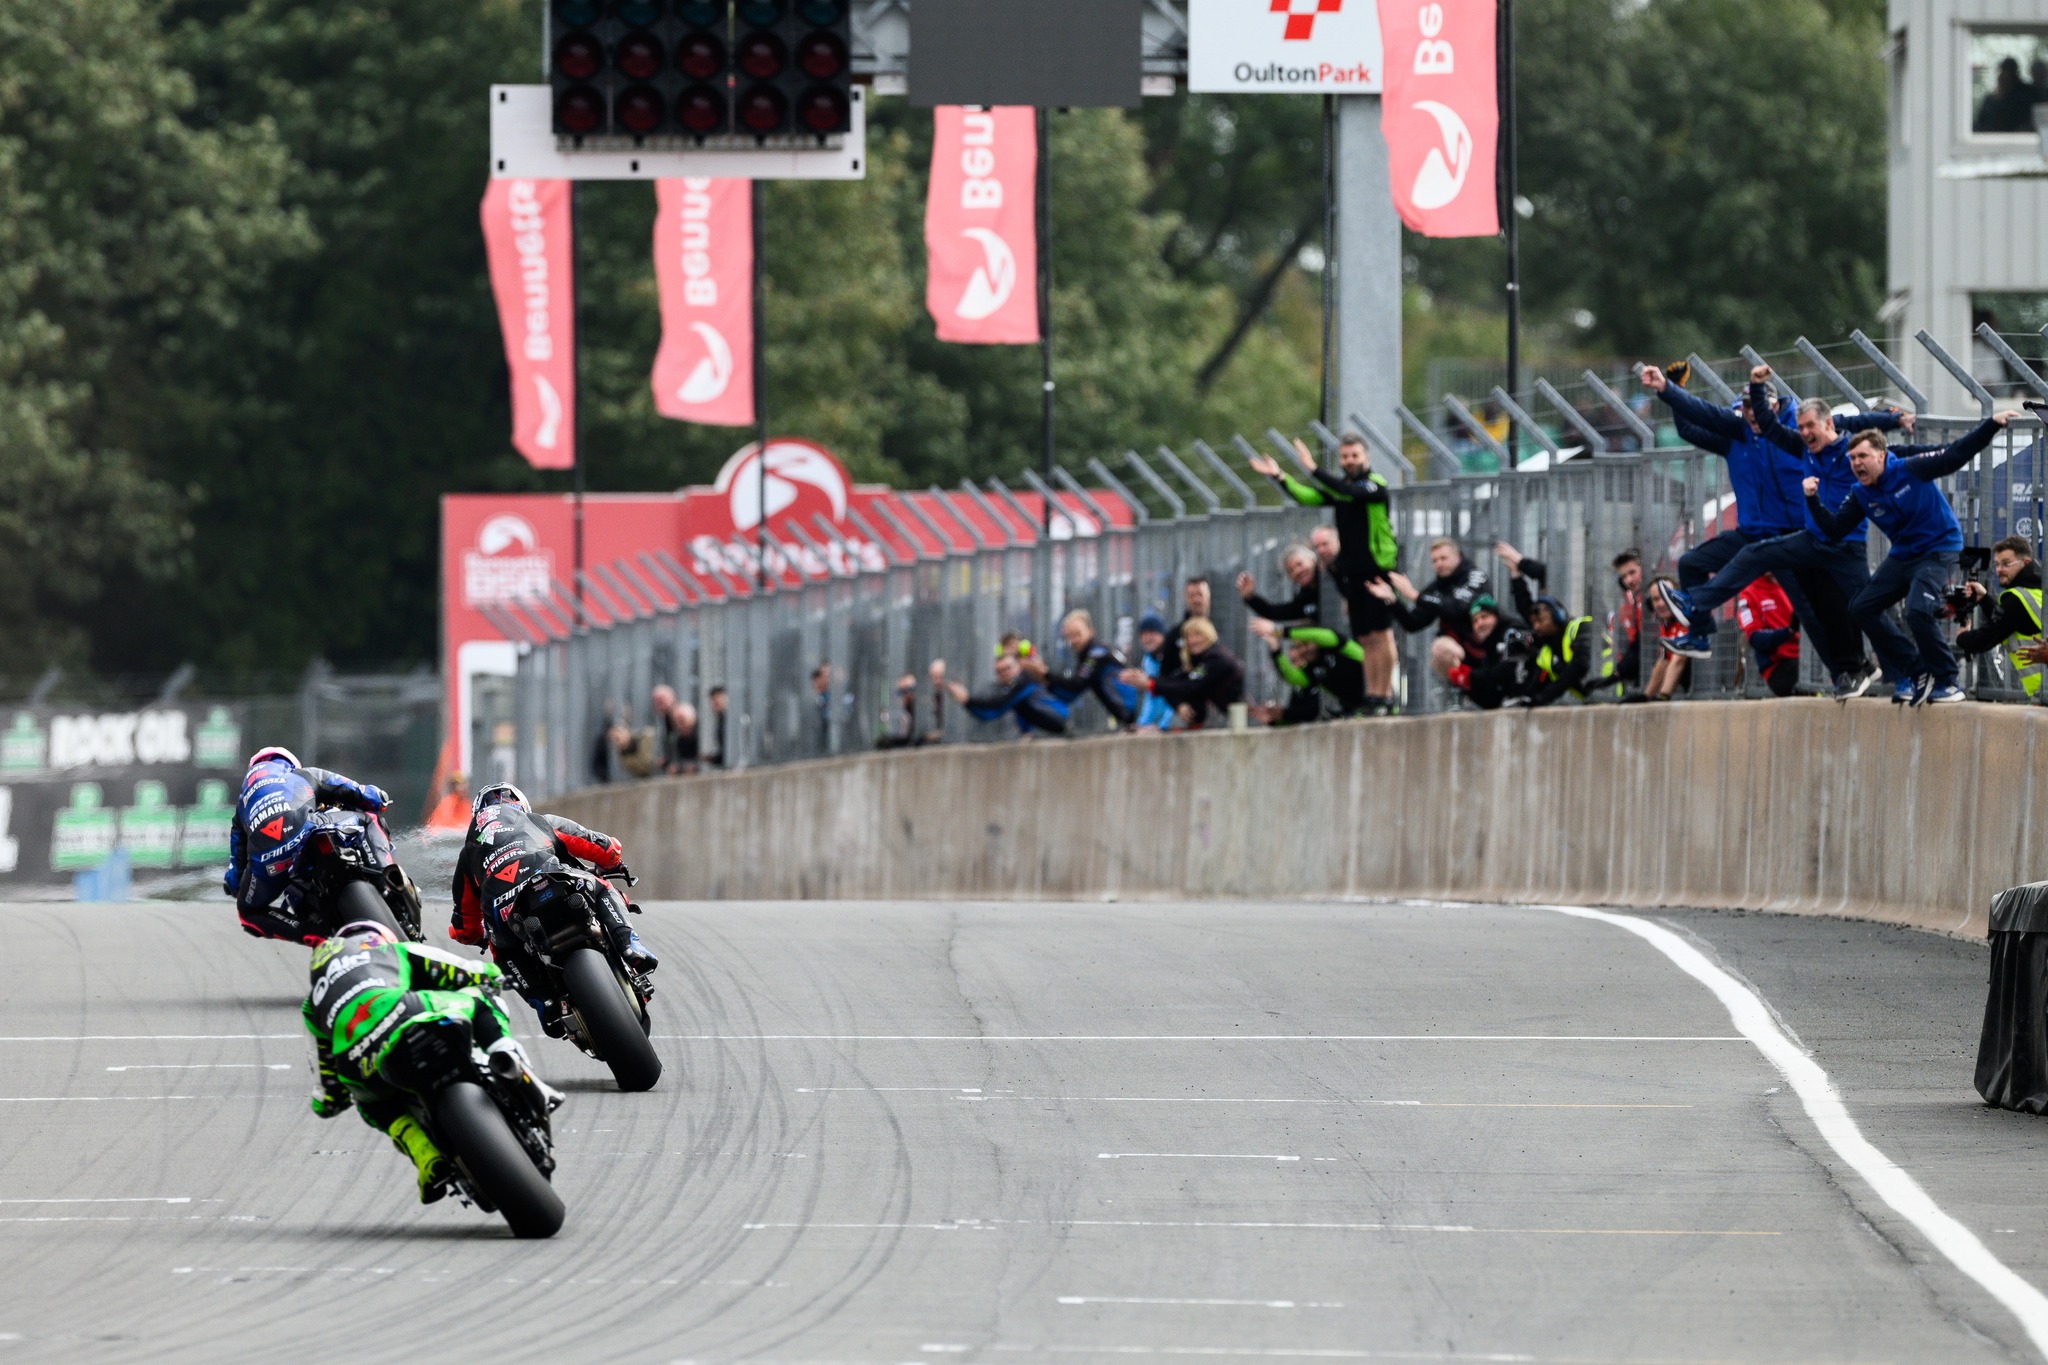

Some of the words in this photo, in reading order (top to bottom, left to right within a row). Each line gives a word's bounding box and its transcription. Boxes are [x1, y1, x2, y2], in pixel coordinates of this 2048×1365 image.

[1234, 61, 1371, 83] OultonPark
[249, 802, 292, 833] YAMAHA
[486, 850, 519, 878] SPIDER
